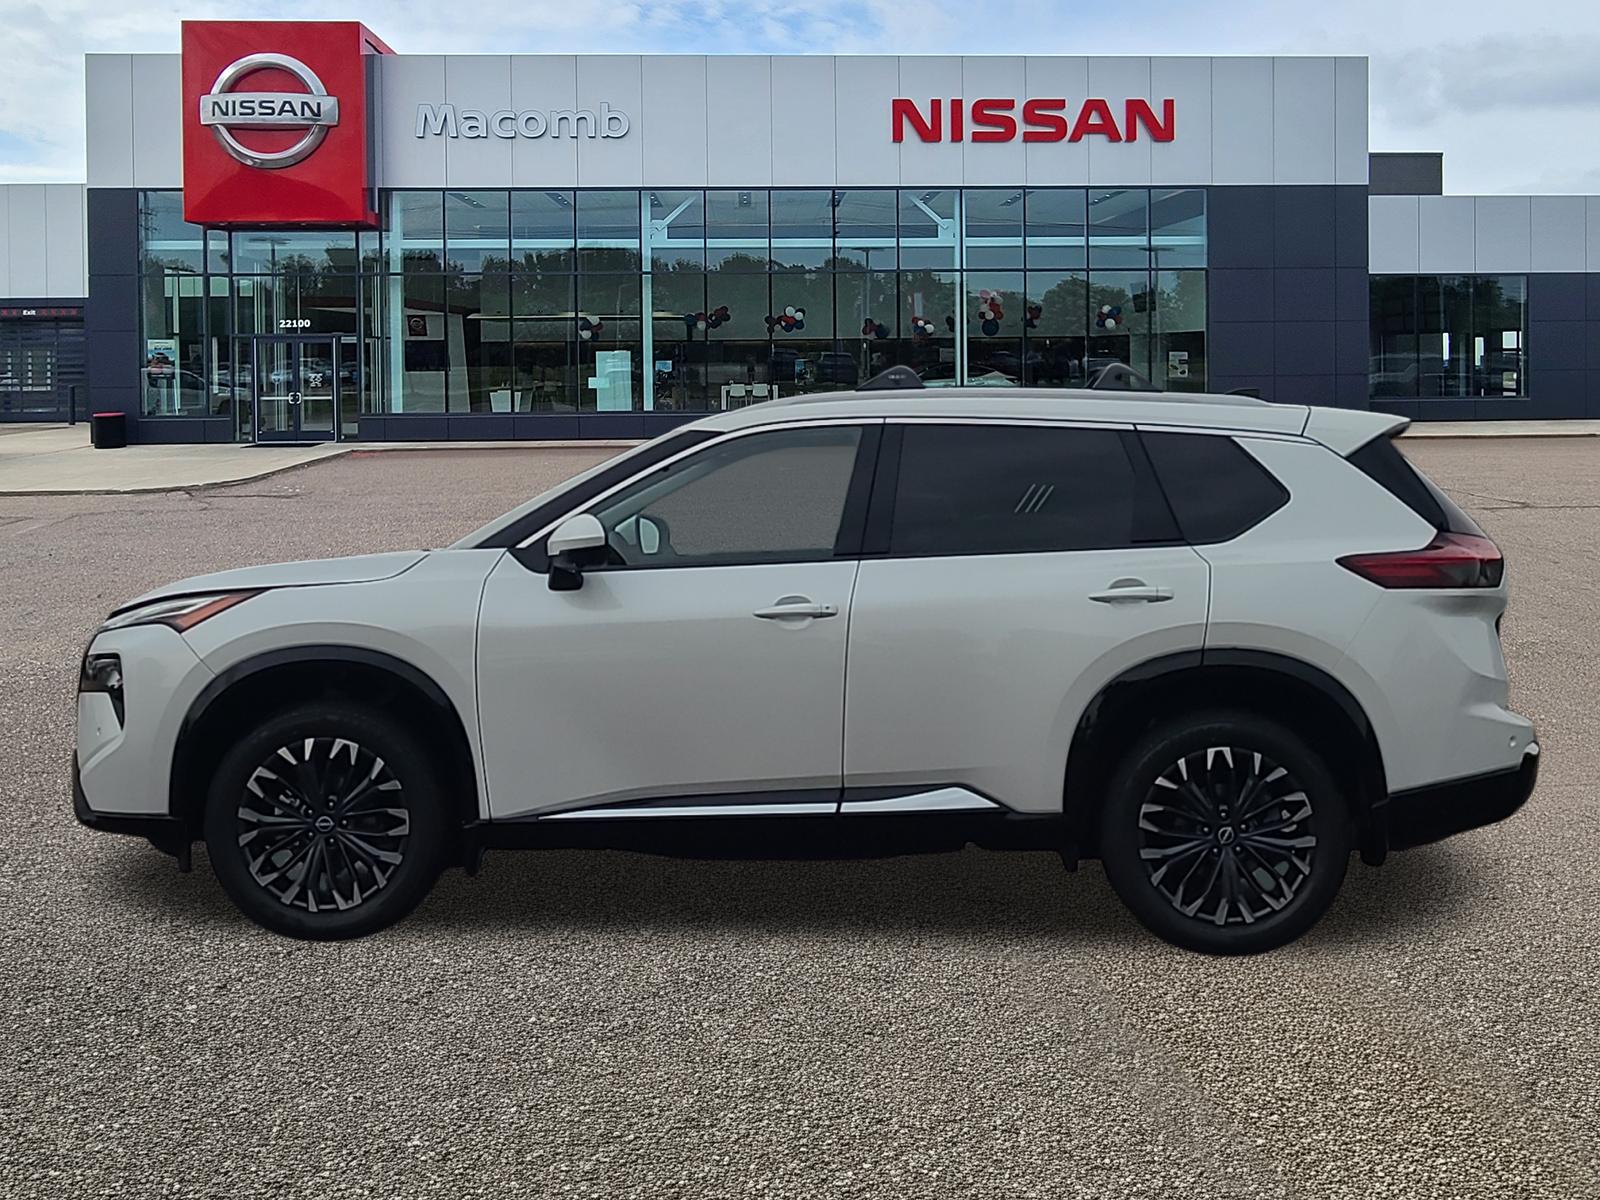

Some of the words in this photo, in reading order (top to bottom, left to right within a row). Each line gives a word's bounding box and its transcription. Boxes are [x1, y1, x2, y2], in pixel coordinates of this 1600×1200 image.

[211, 100, 322, 118] NISSAN
[415, 101, 630, 139] Macomb
[892, 98, 1175, 143] NISSAN
[279, 319, 311, 328] 22100
